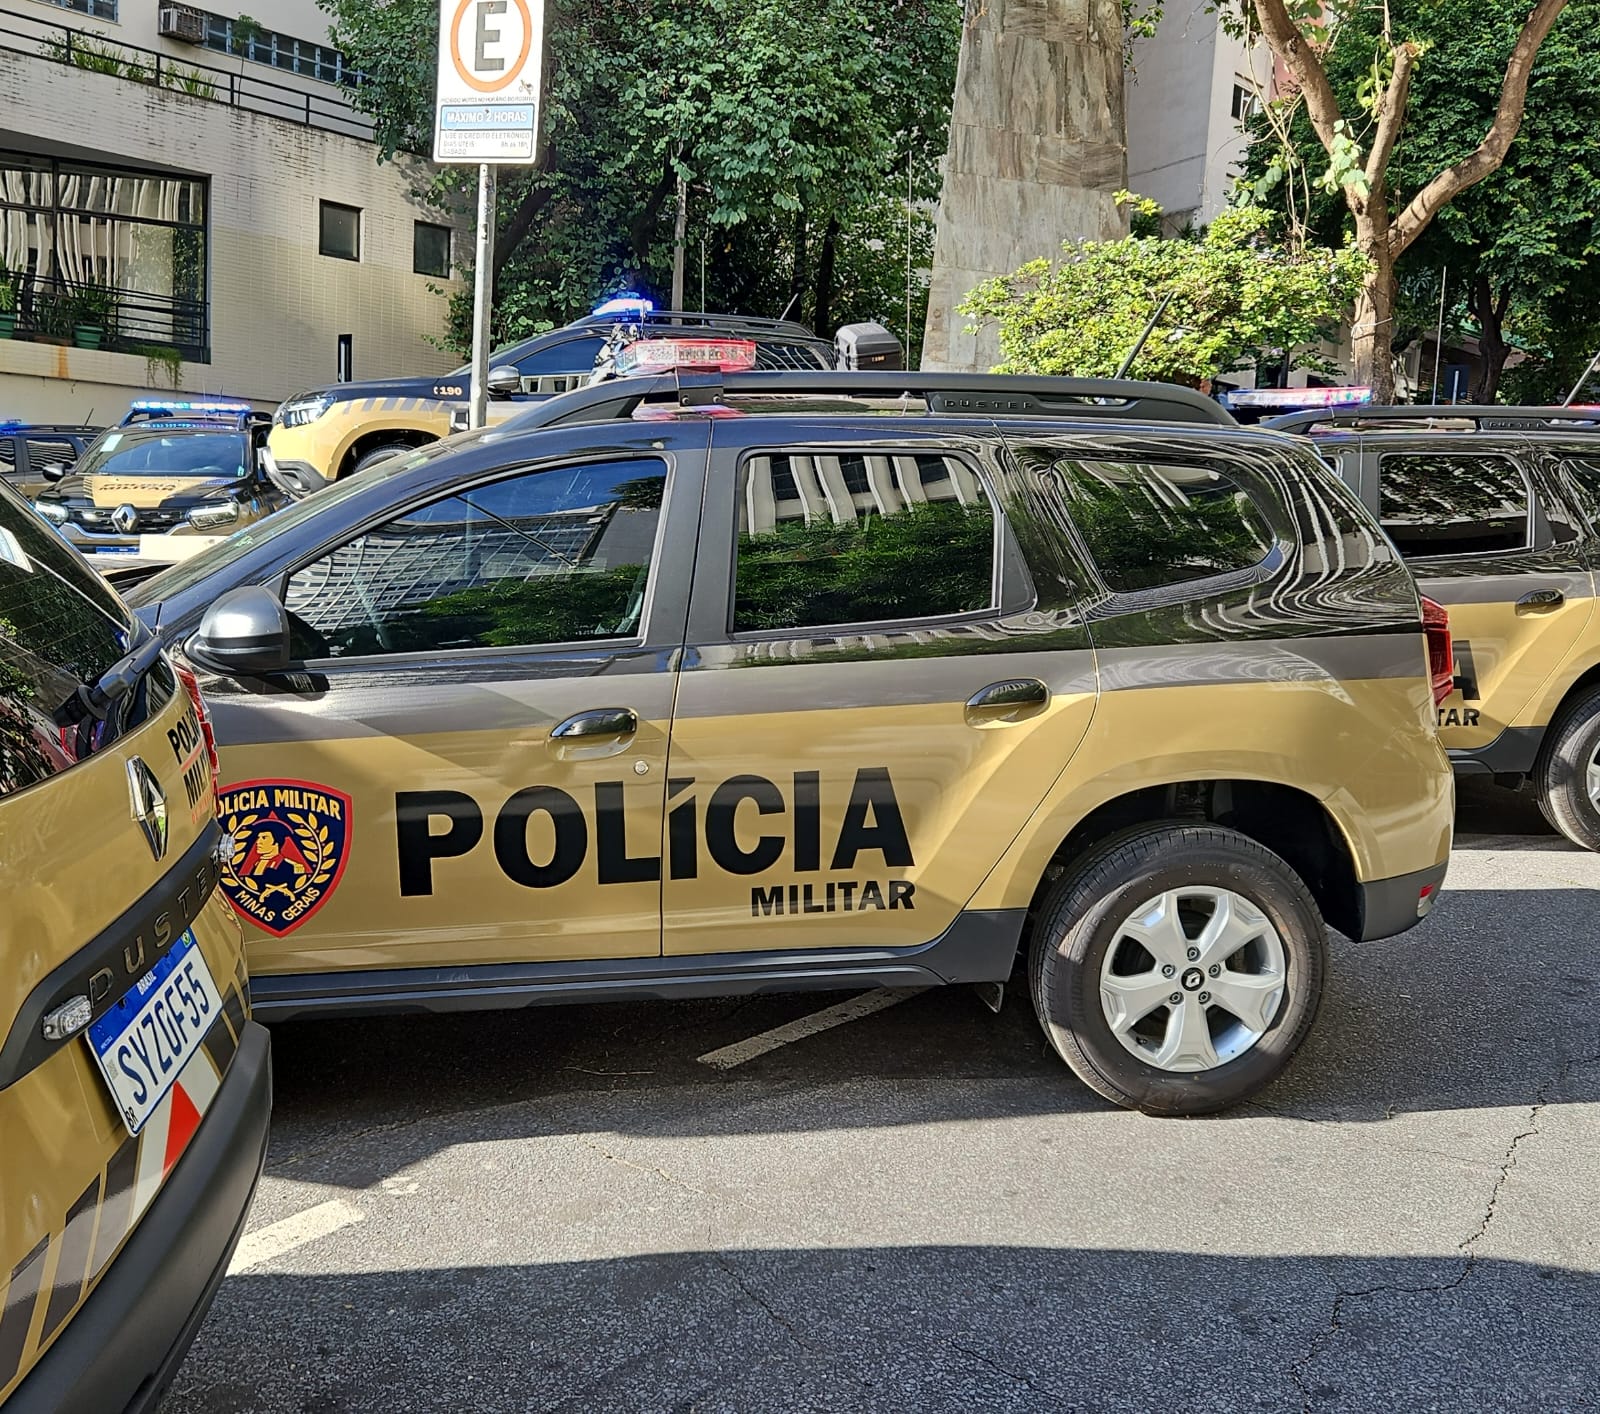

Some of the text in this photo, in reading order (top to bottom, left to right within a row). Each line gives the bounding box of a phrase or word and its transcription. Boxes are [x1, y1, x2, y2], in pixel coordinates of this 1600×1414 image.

[475, 1, 507, 71] E
[494, 111, 528, 122] HORAS
[439, 386, 463, 396] 190
[944, 399, 1034, 409] DUSTER
[274, 789, 342, 821] MILITAR
[395, 767, 915, 897] POLÍCIA
[235, 886, 321, 922] MINAS GERAIS
[751, 879, 916, 917] MILITAR
